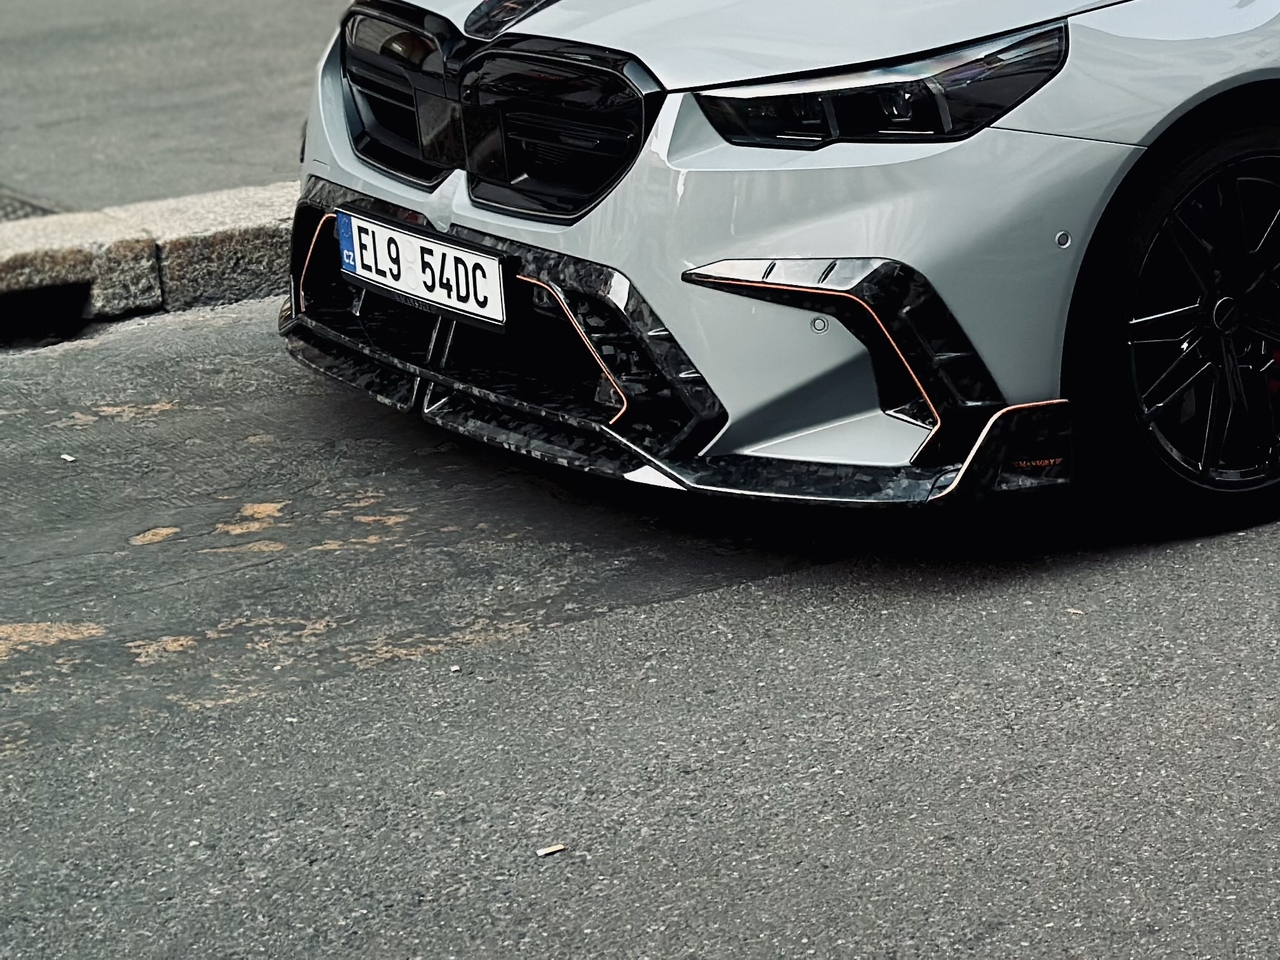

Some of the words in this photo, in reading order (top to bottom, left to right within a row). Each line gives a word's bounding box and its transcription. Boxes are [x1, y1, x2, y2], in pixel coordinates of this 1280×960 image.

[343, 249, 355, 266] CZ
[357, 225, 401, 282] EL9
[420, 245, 489, 309] 54DC
